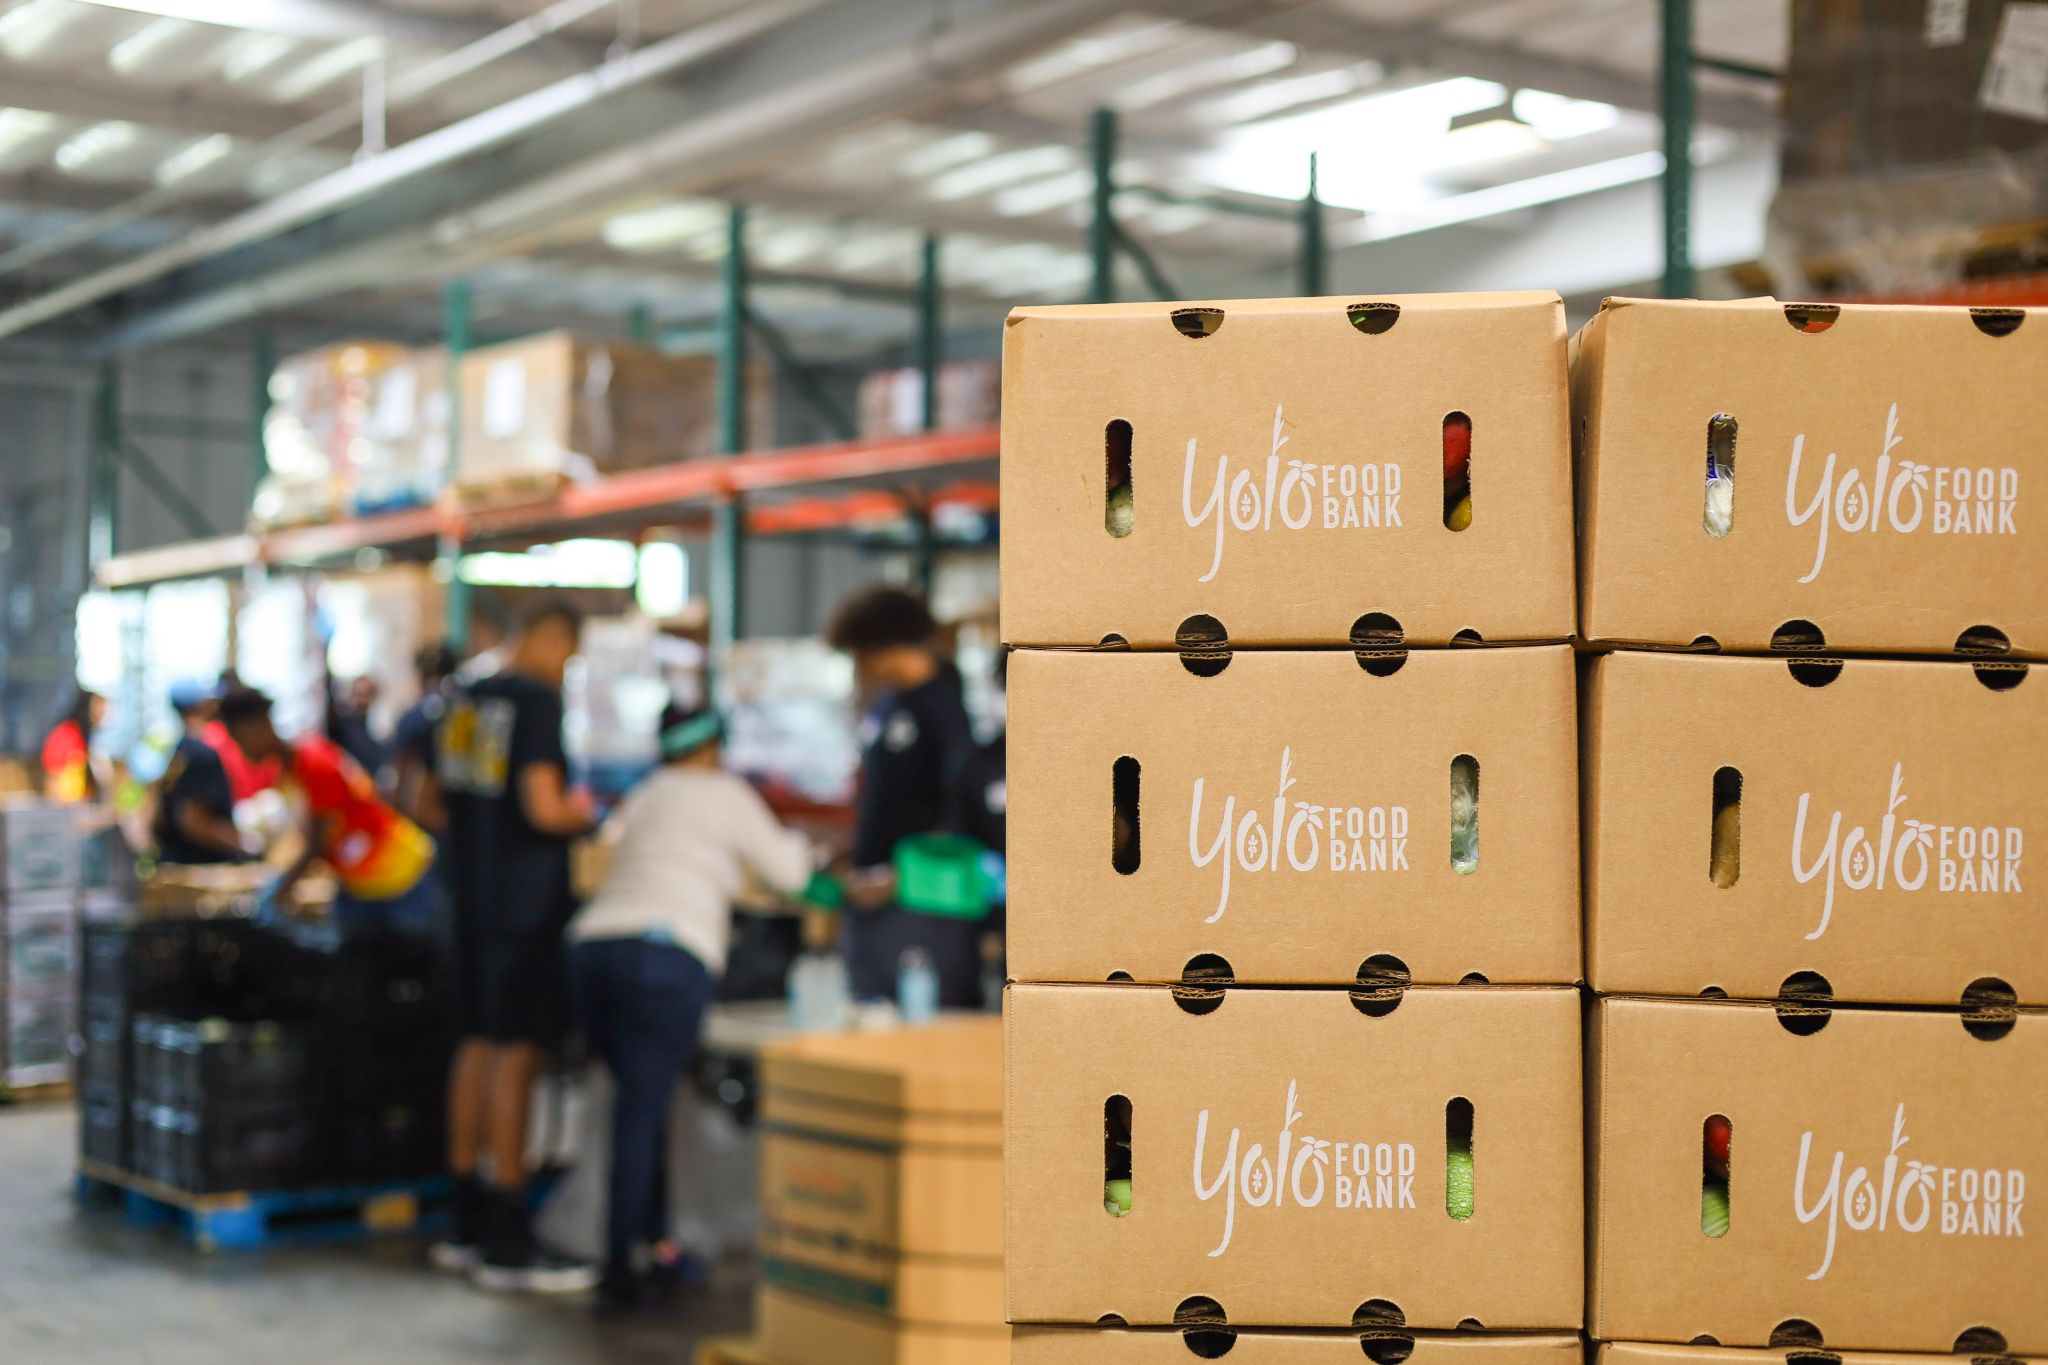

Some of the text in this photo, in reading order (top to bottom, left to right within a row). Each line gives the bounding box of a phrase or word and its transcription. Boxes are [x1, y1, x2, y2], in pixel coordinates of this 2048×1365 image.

[1321, 463, 1402, 497] FOOD
[1935, 467, 2018, 501] FOOD
[1323, 495, 1403, 529] BANK
[1933, 500, 2017, 534] BANK
[1329, 806, 1409, 840] FOOD
[1330, 838, 1410, 872] BANK
[1939, 826, 2023, 859] FOOD
[1939, 858, 2022, 892] BANK
[1335, 1142, 1416, 1176] FOOD
[1335, 1174, 1416, 1209] BANK
[1942, 1168, 2024, 1202] FOOD
[1942, 1201, 2024, 1235] BANK
